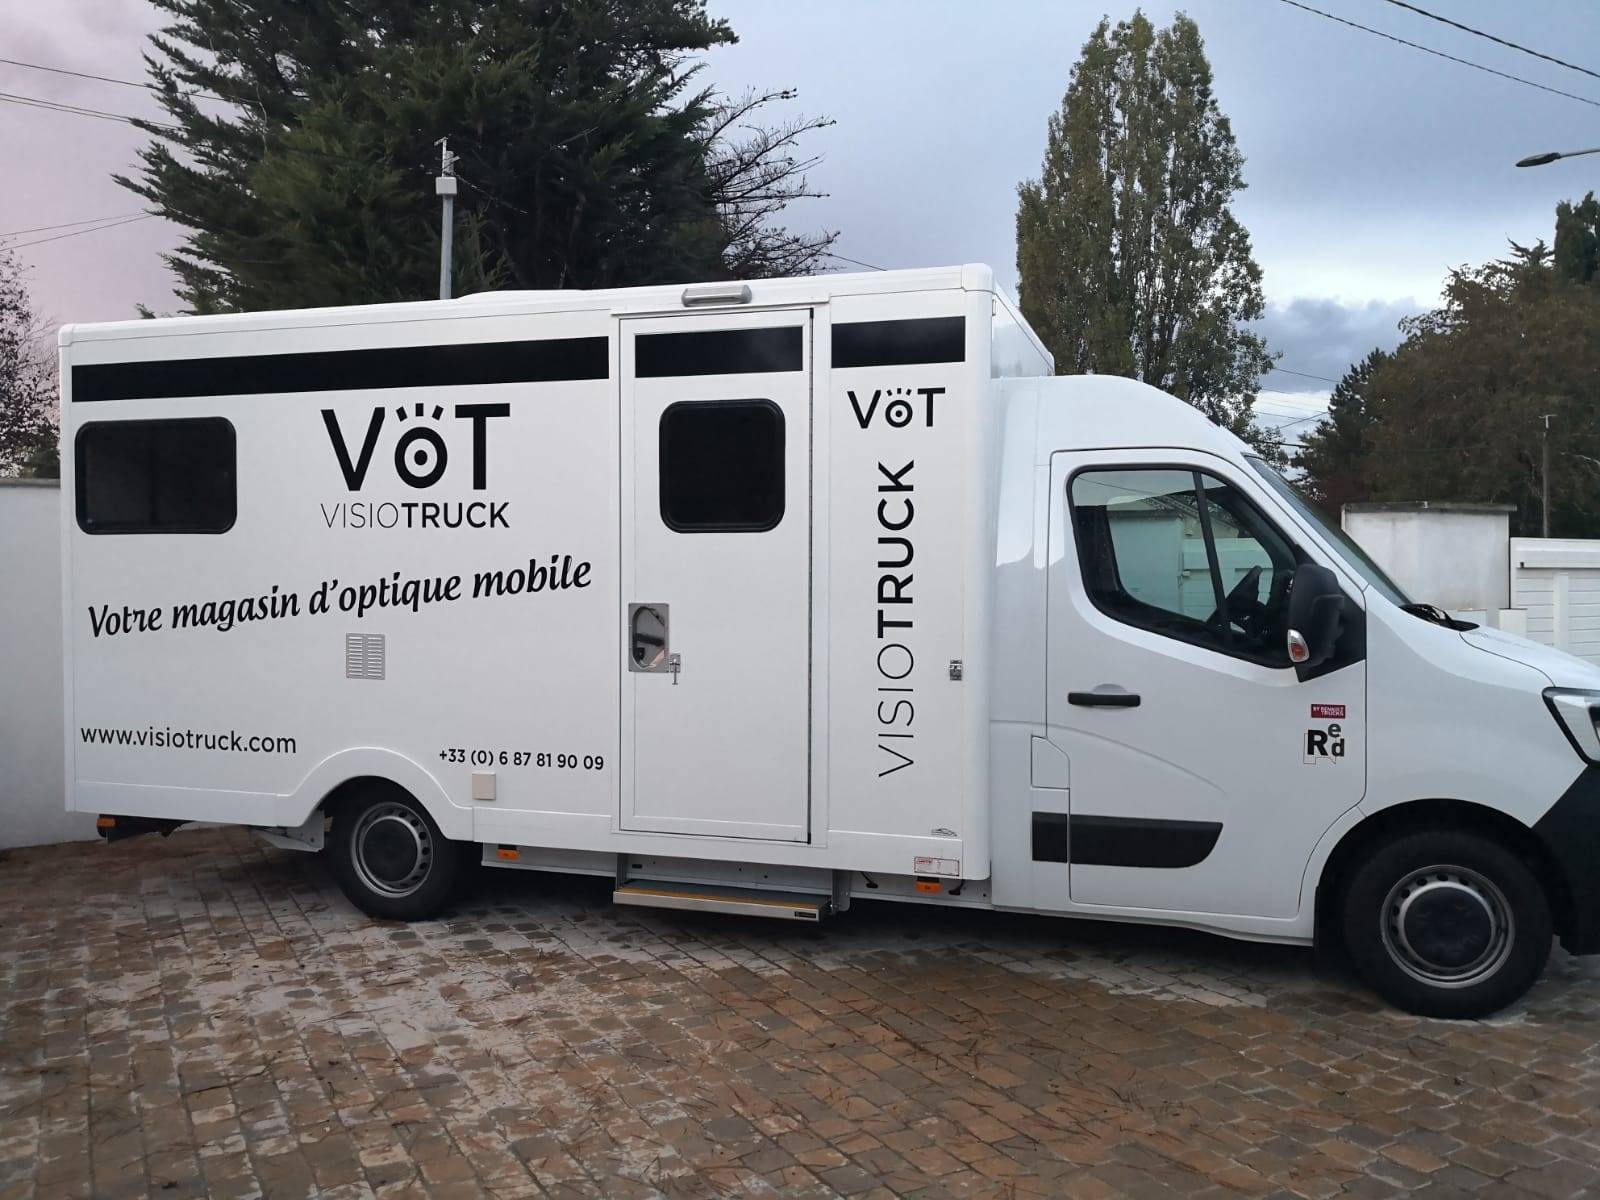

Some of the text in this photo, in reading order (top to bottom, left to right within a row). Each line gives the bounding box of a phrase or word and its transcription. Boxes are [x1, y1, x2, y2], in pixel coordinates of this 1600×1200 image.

[320, 501, 511, 529] VISIOTRUCK
[87, 554, 592, 638] Votre magasin d'optique mobile
[877, 459, 916, 778] VISIOTRUCK
[80, 725, 297, 754] www.visiotruck.com
[439, 748, 604, 771] +33 (0) 6 87 81 90 09
